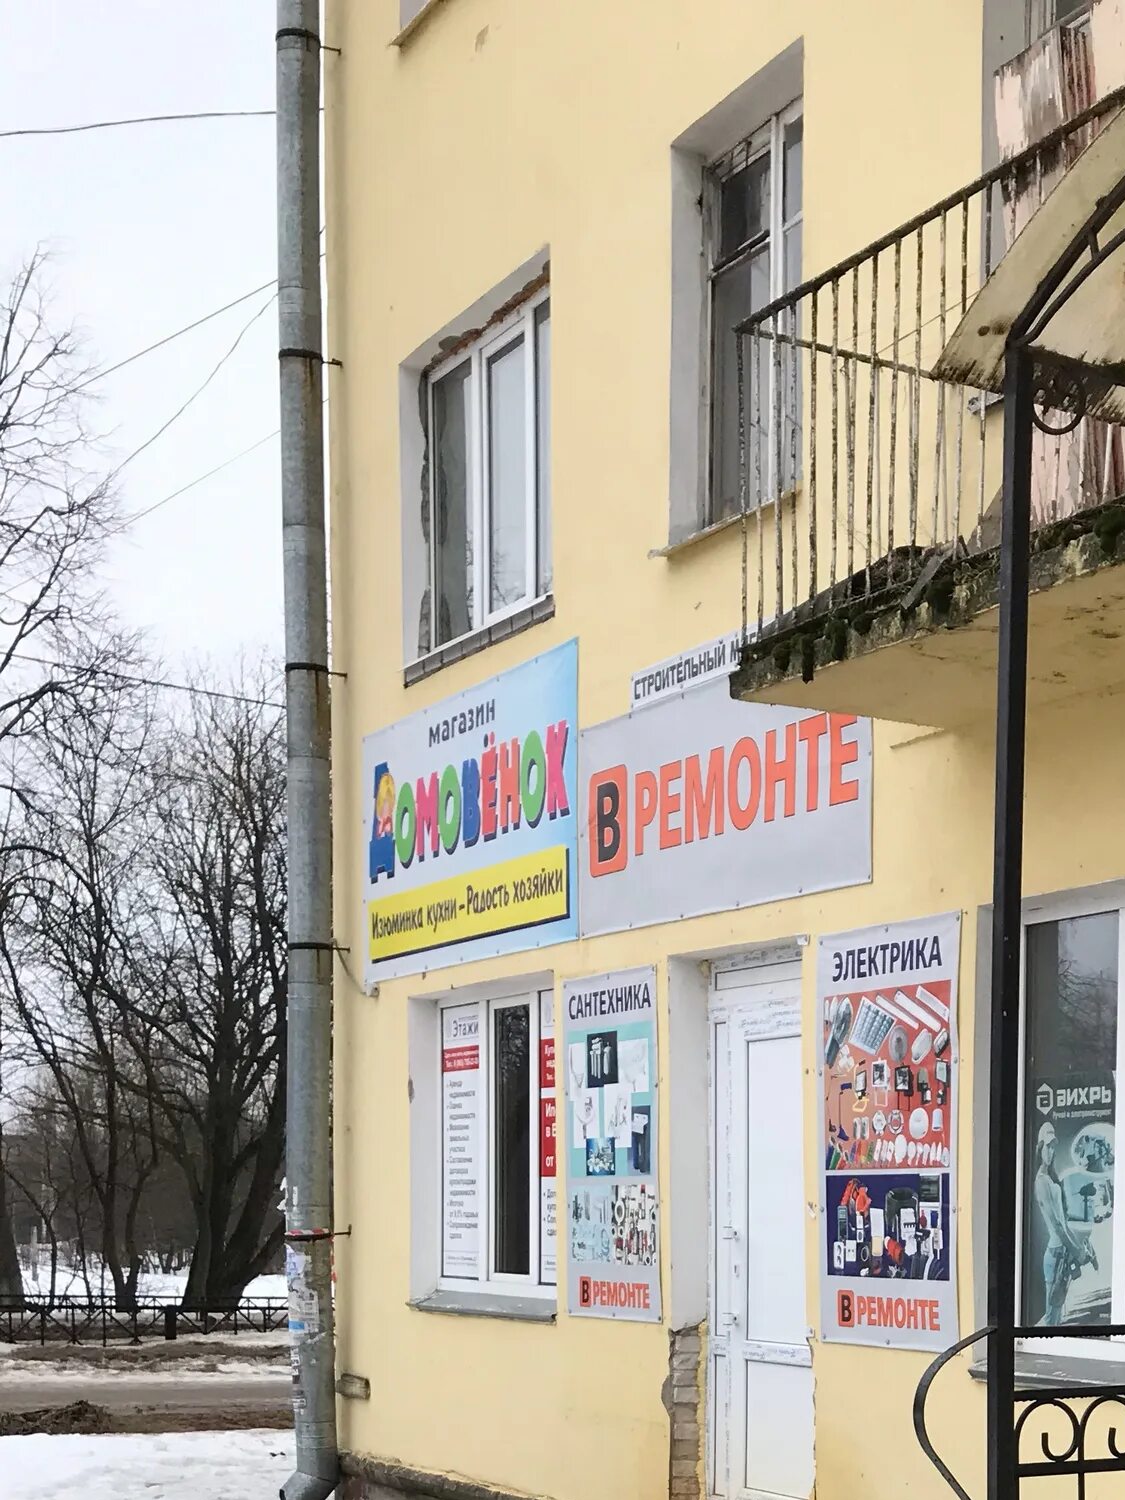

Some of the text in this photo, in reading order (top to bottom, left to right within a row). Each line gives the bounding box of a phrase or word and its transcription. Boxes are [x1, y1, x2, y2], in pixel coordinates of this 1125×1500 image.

[634, 641, 726, 700] СТРОИТЕЛЬНЫЙ
[428, 699, 496, 748] магазин
[597, 712, 859, 863] В РЕМОНТЕ
[371, 907, 423, 940] Изюминка
[426, 898, 457, 933] кухни
[466, 885, 509, 915] Радость
[513, 868, 563, 903] хозяйки
[832, 935, 942, 982] ЭЛЕКТРИКА
[568, 982, 651, 1020] САНТЕХНИКА
[592, 1281, 650, 1309] РЕМОНТЕ
[857, 1296, 940, 1331] РЕМОНТЕ
